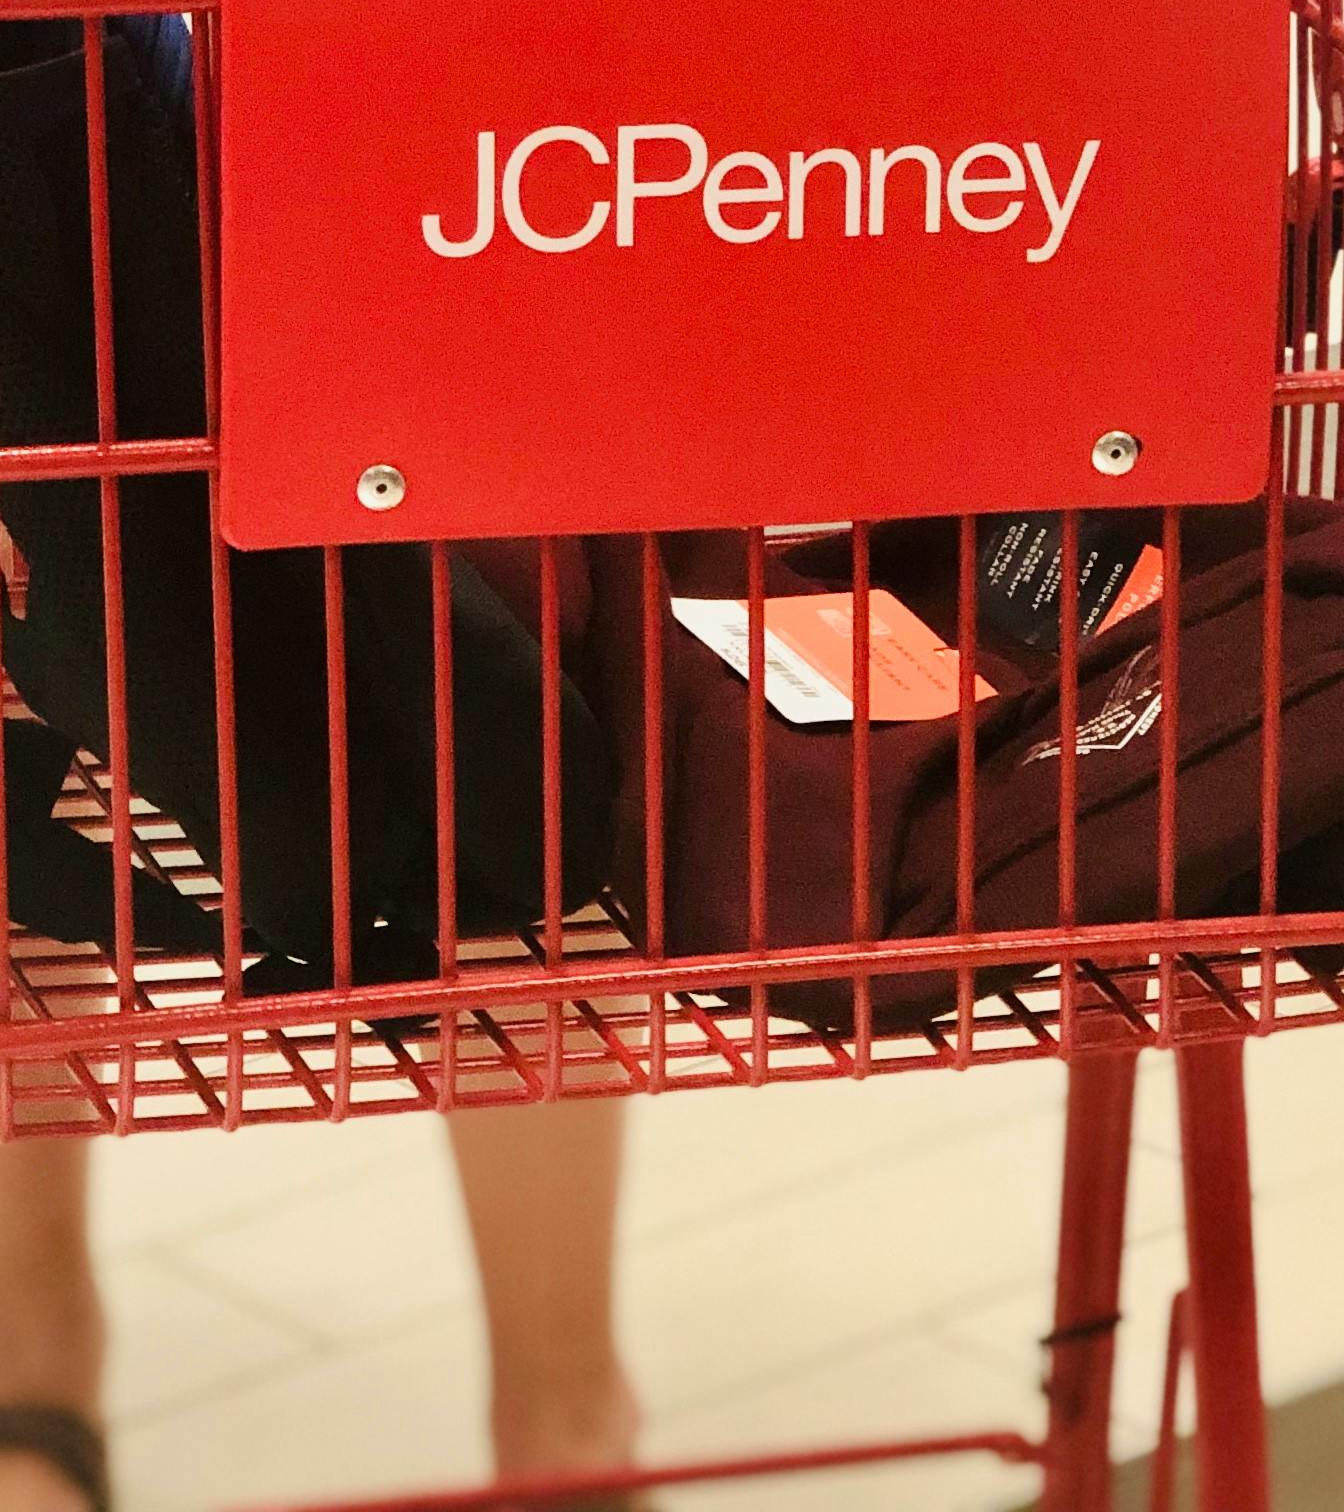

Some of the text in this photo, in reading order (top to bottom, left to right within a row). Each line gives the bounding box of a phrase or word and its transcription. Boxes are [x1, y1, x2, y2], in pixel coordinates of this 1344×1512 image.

[422, 124, 1101, 263] JCPenney
[988, 525, 1017, 577] COLLAR
[990, 522, 1029, 586] NON-ROLL
[1007, 528, 1047, 599] RESISTANT
[1022, 549, 1044, 583] FADE
[1080, 551, 1099, 586] EASY
[1044, 569, 1062, 603] RINK
